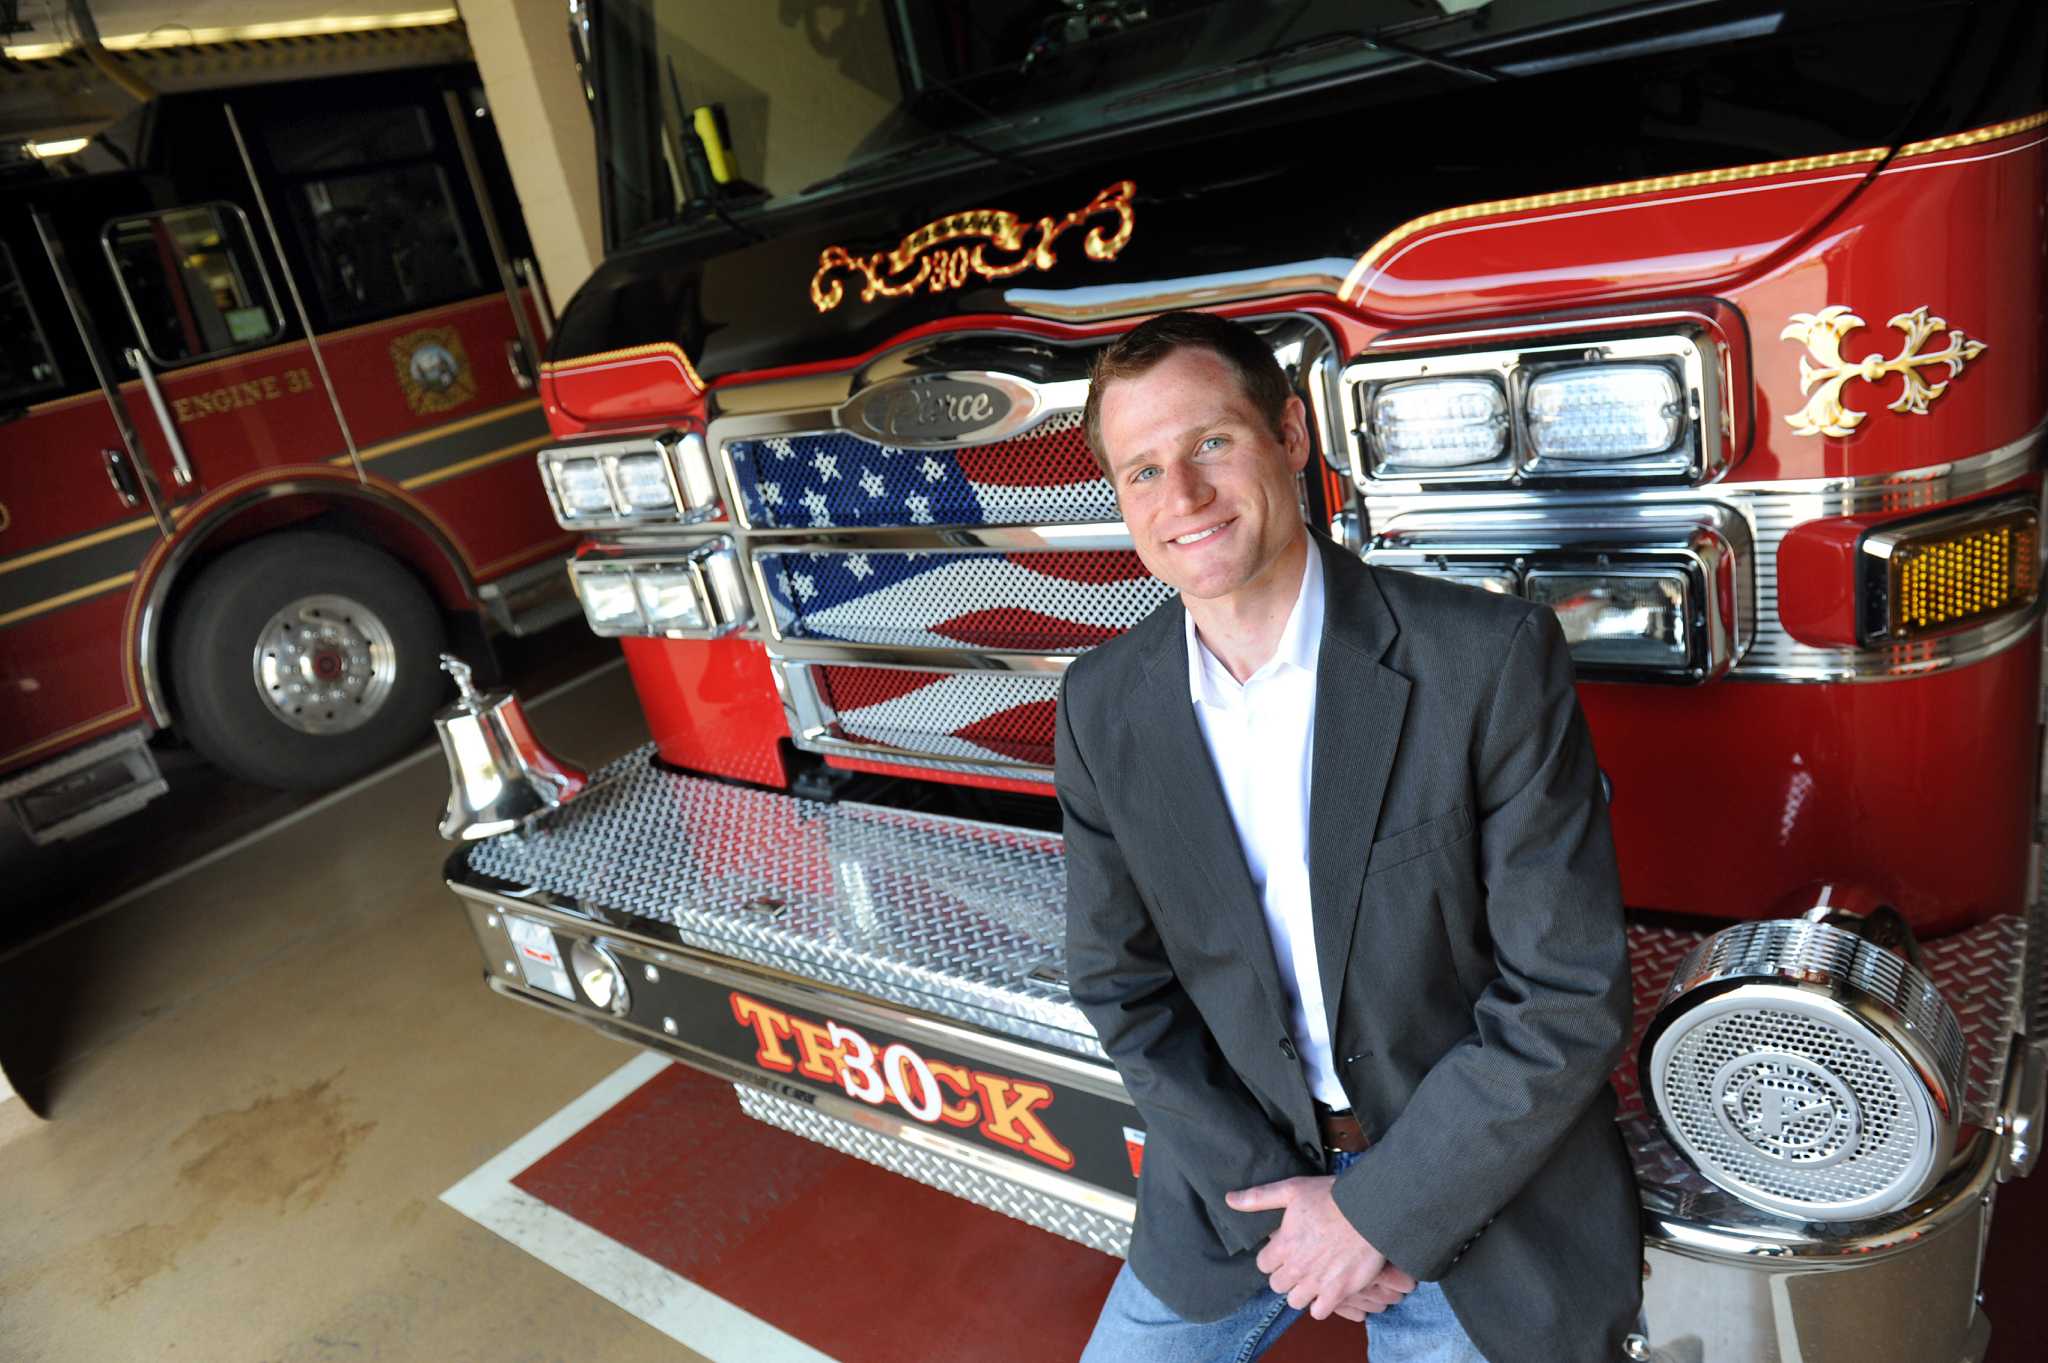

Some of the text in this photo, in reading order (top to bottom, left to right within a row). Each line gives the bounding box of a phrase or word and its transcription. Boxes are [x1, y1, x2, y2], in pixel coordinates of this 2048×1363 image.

[930, 247, 969, 293] 30
[174, 367, 313, 423] ENGINE 31
[827, 1021, 943, 1122] 30
